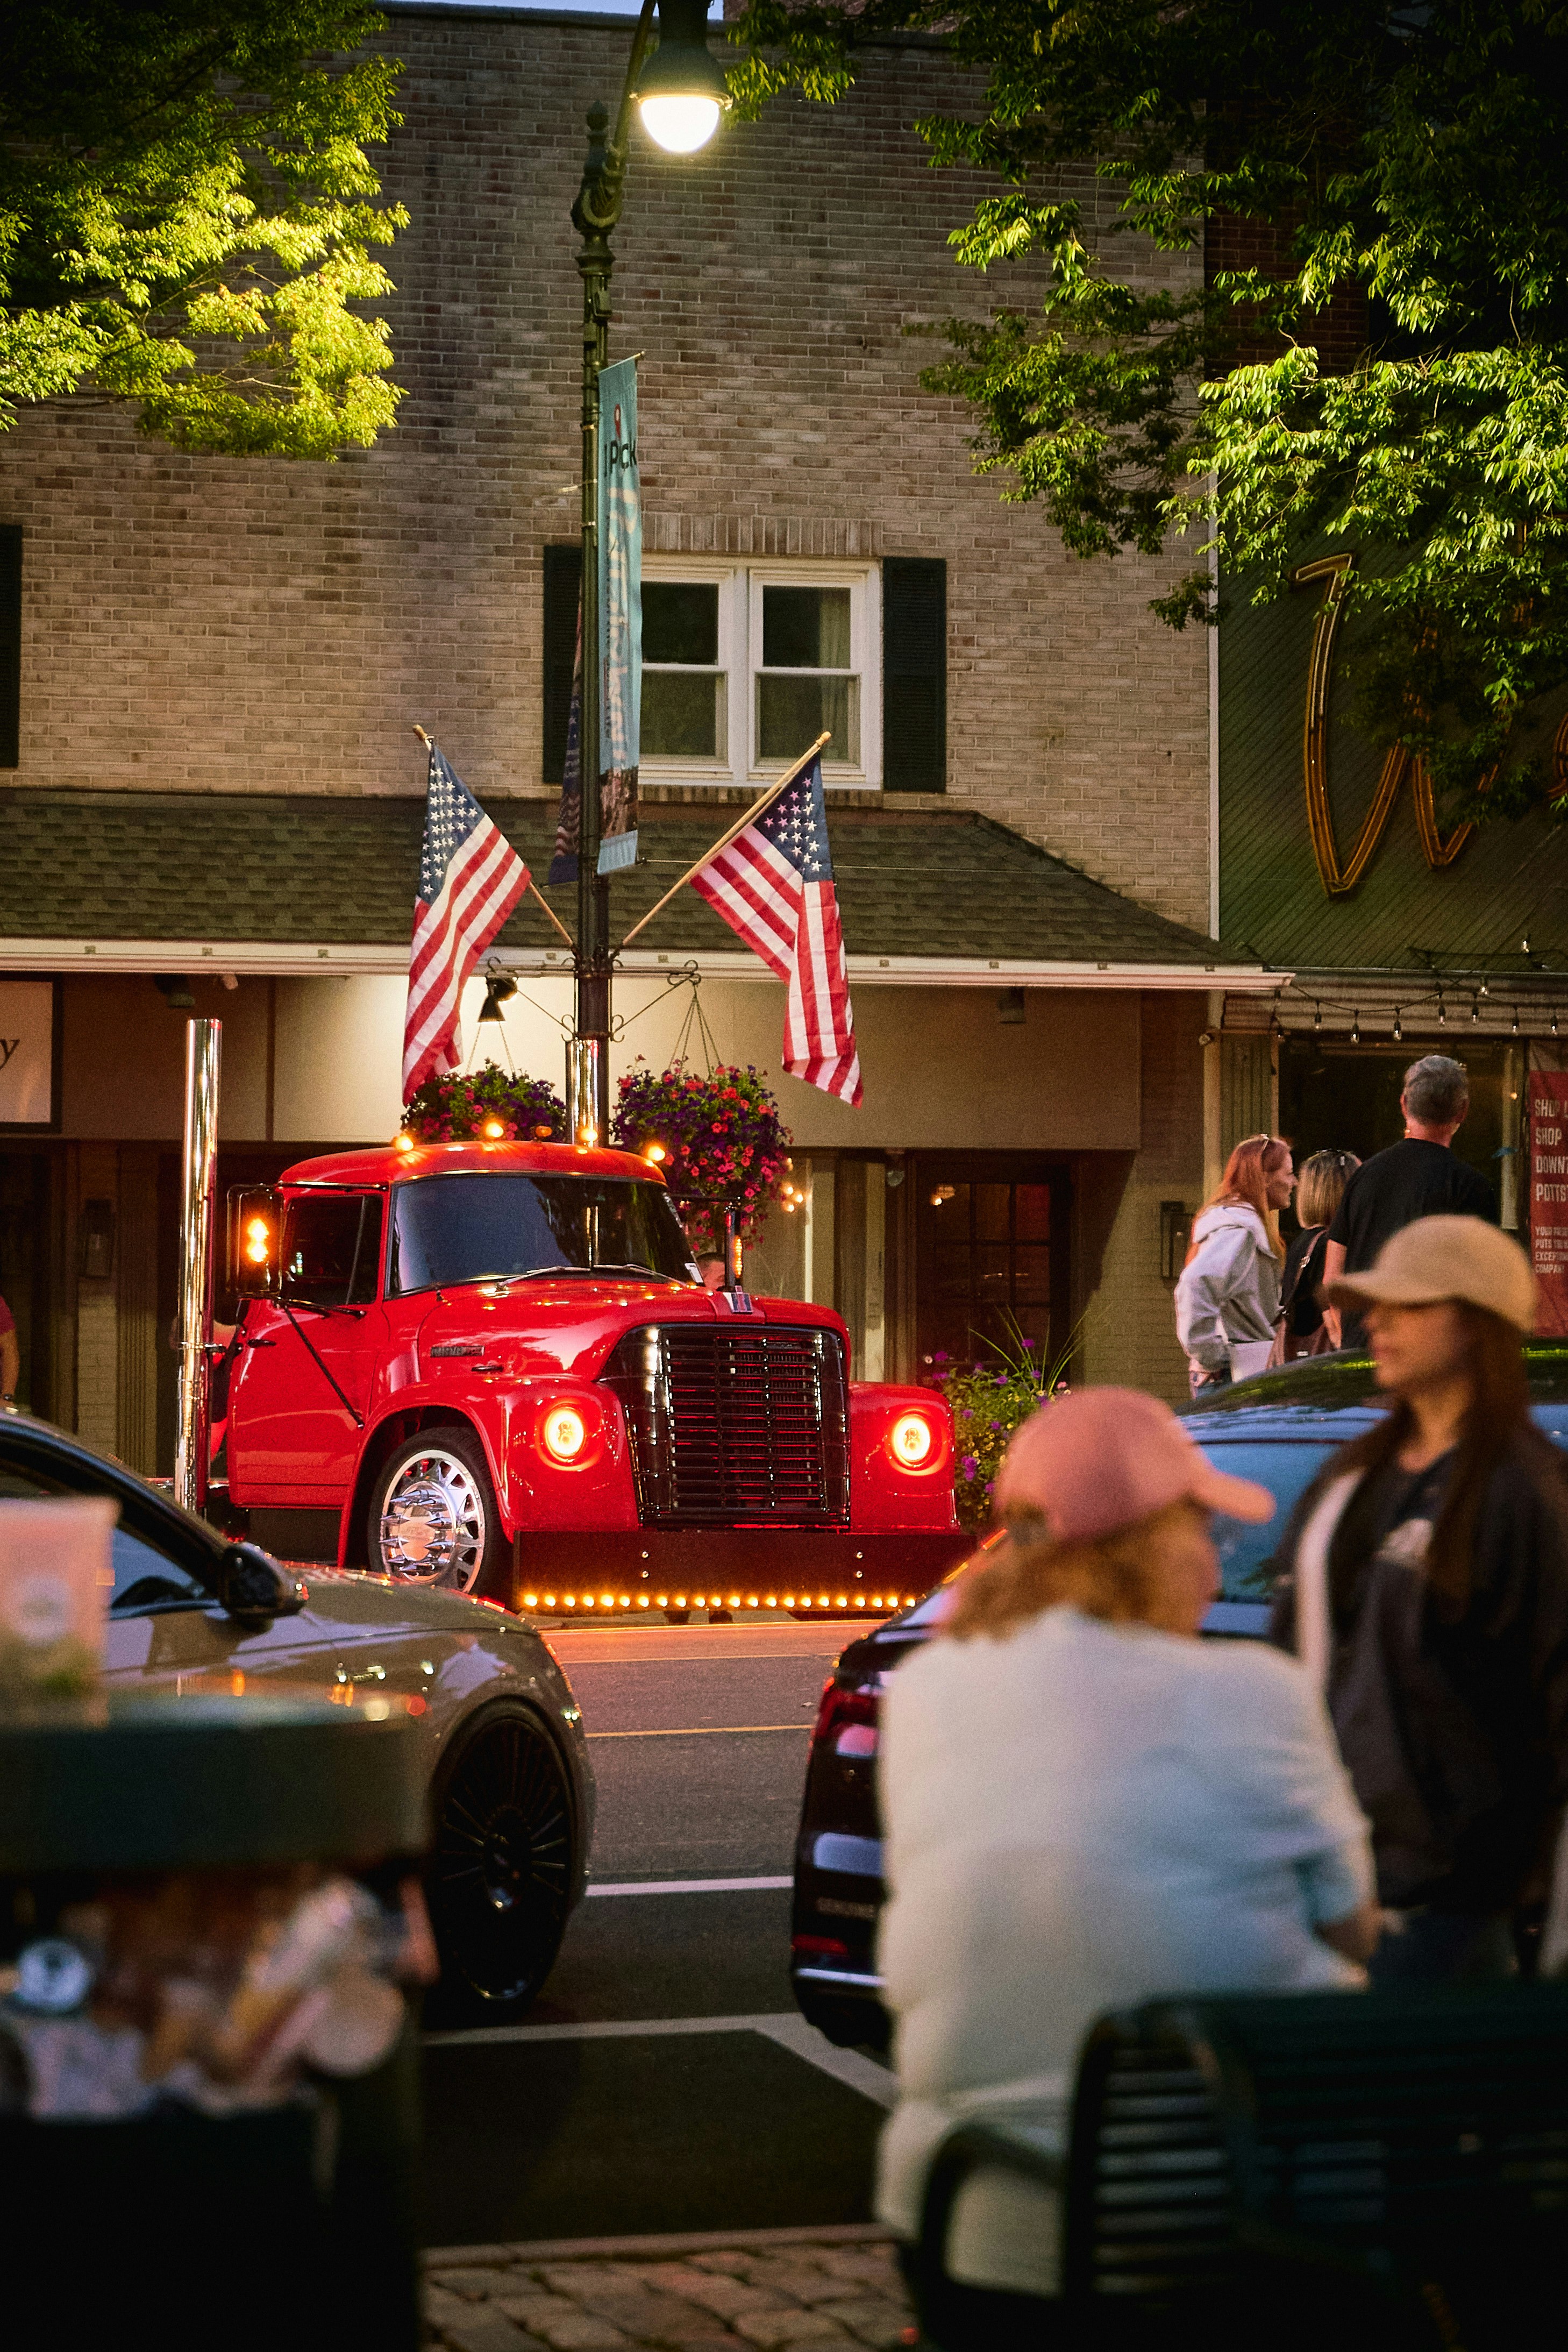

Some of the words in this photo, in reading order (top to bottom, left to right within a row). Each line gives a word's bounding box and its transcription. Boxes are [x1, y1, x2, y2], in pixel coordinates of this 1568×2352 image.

[1535, 1099, 1560, 1117] SHOP
[1536, 1127, 1563, 1146] SHOP
[1536, 1183, 1568, 1203] POTTS
